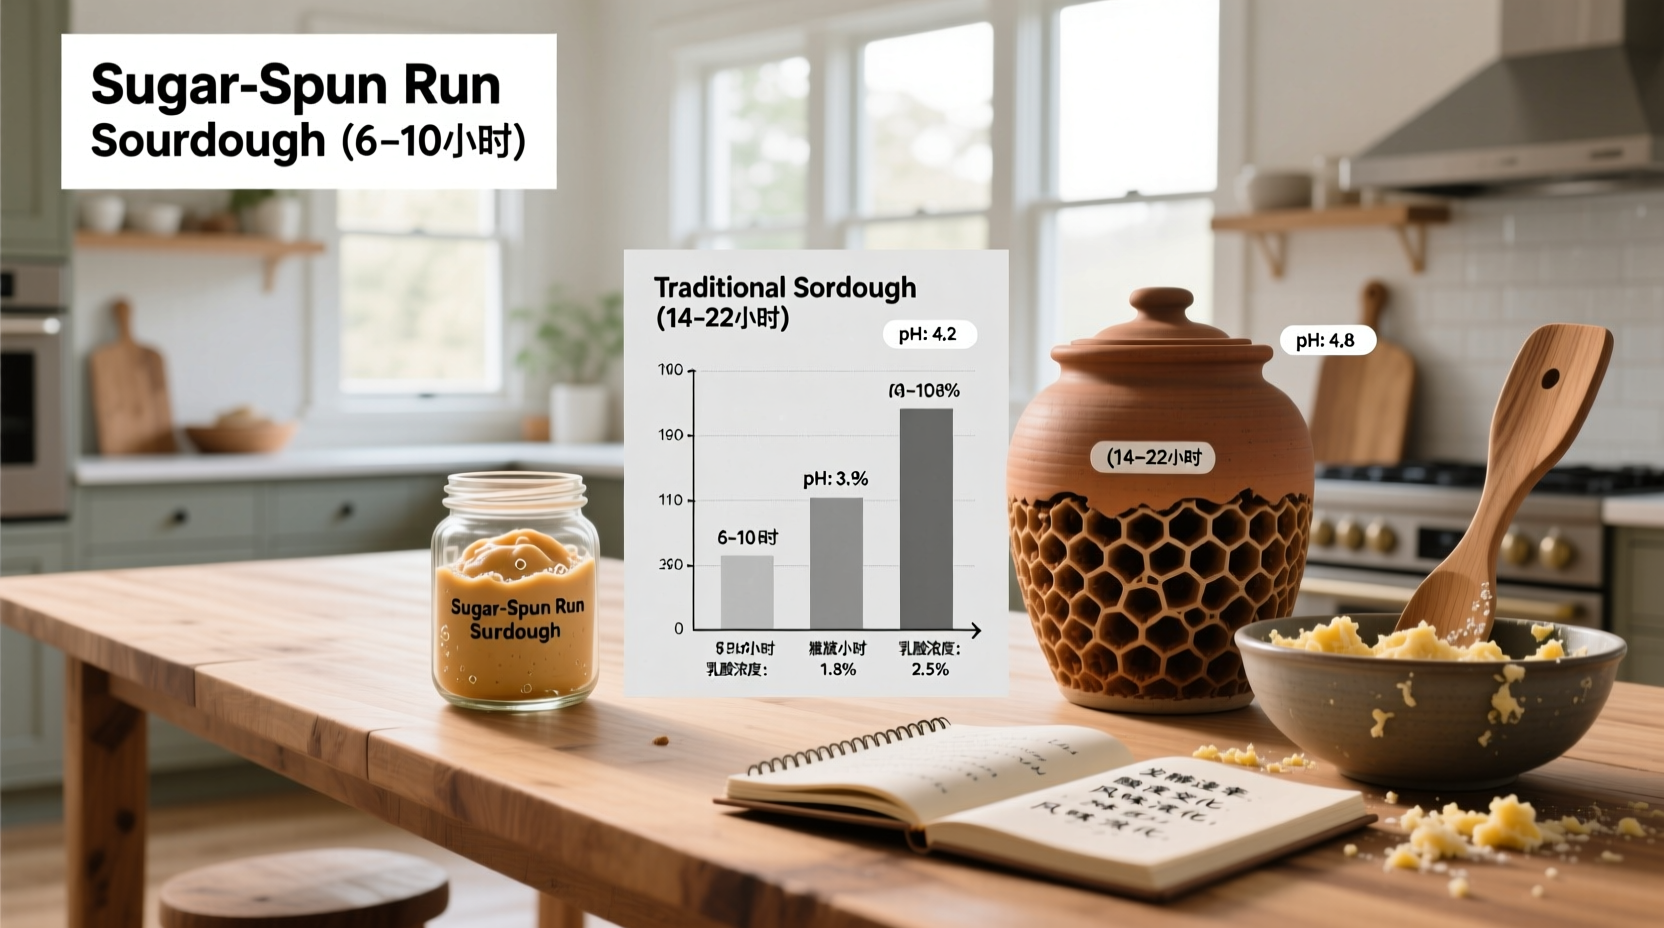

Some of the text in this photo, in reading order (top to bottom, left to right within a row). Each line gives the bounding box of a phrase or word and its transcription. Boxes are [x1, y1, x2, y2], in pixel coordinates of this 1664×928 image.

[451, 597, 585, 621] Sugar-Spun Run
[470, 621, 561, 643] Surdough
